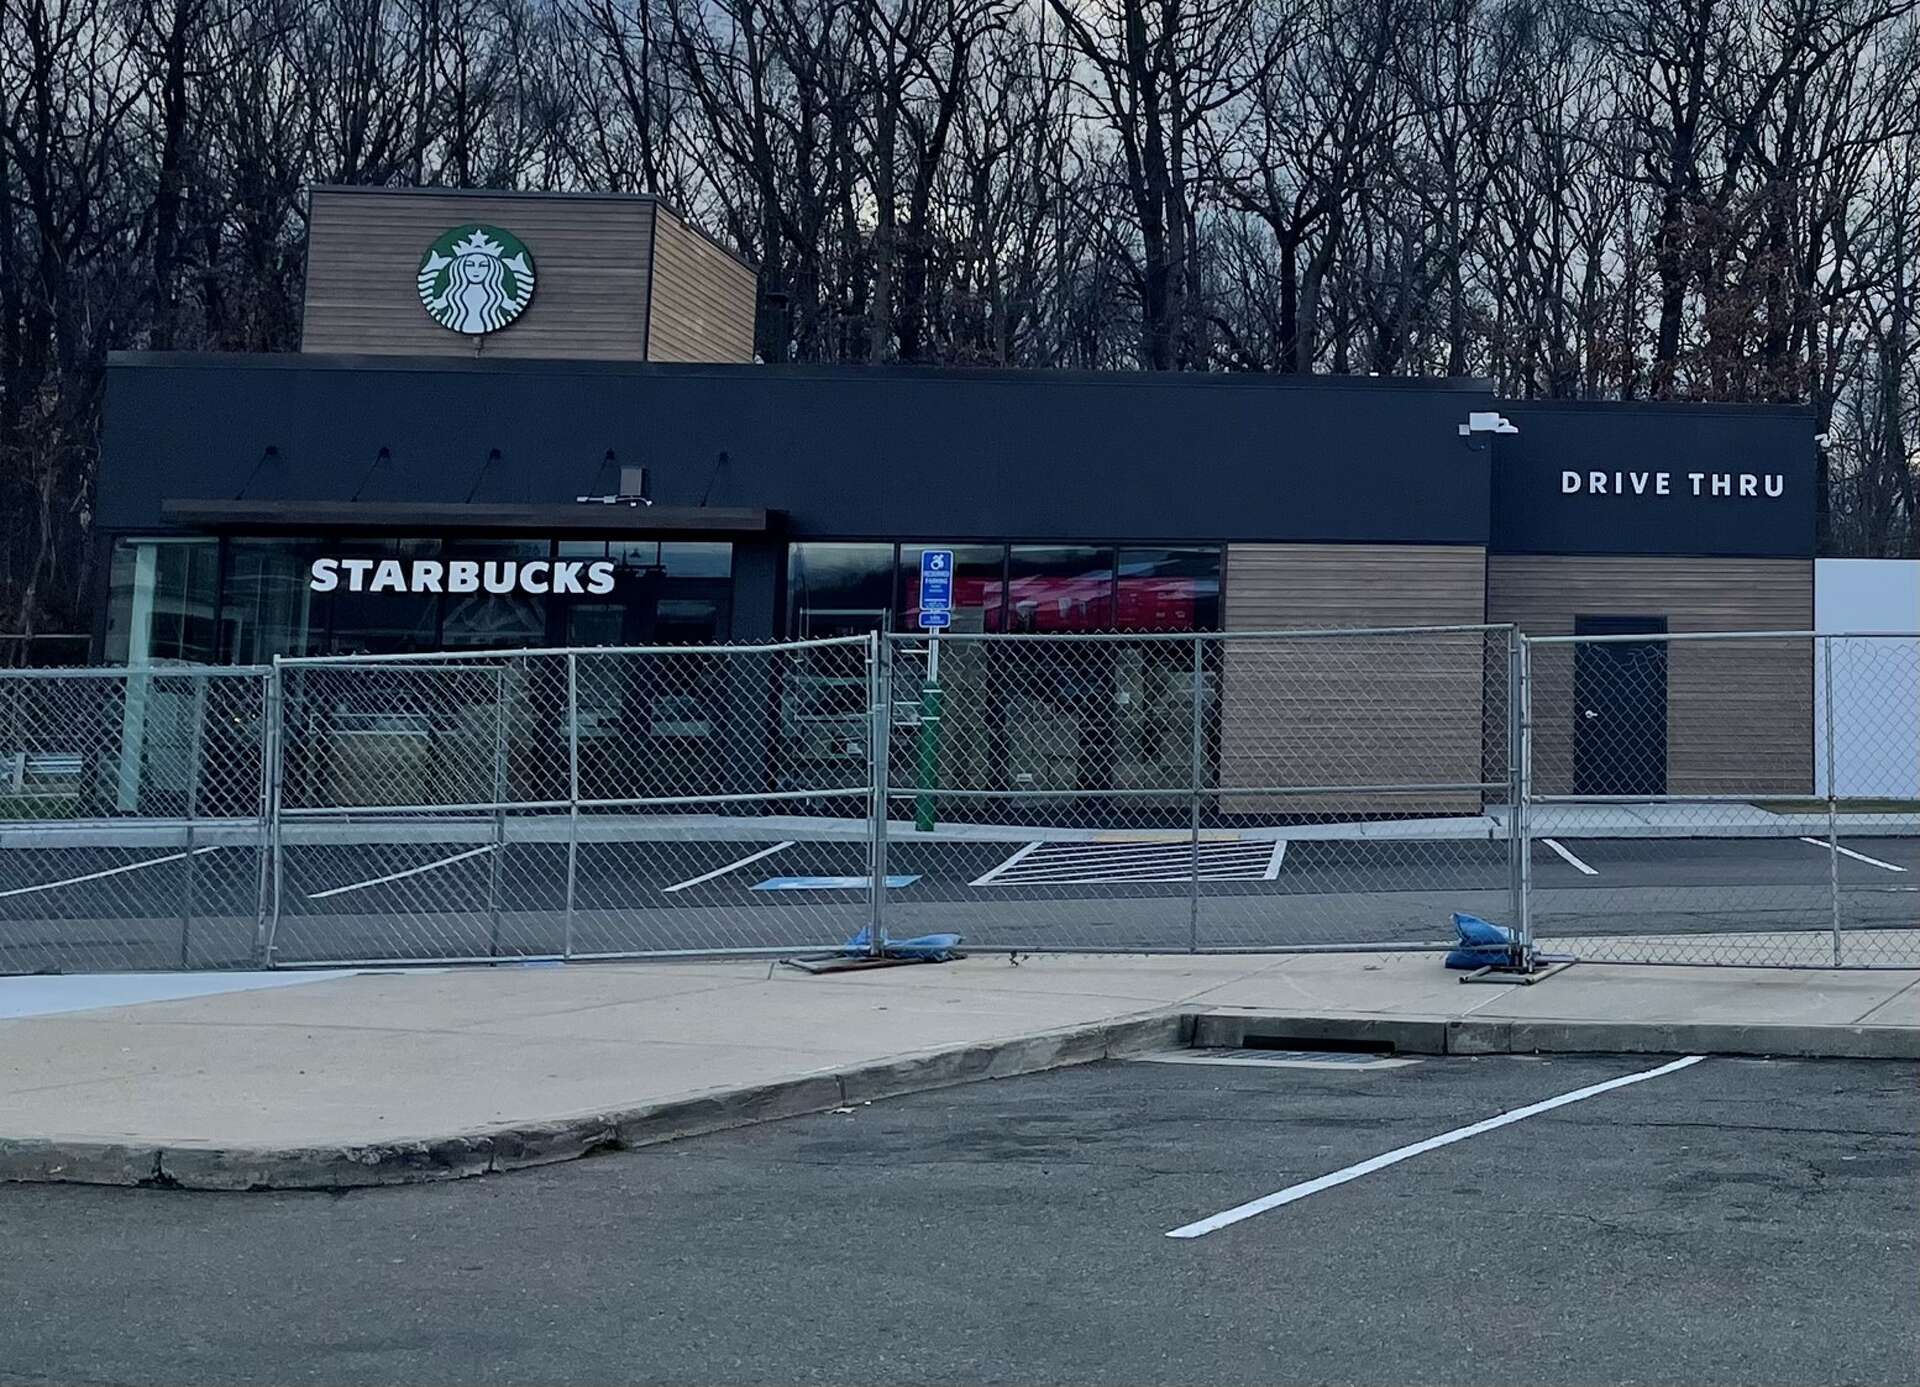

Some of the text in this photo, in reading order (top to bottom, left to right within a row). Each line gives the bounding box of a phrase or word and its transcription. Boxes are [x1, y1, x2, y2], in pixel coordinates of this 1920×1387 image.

[1561, 471, 1785, 497] DRIVE THRU
[309, 558, 616, 595] STARBUCKS
